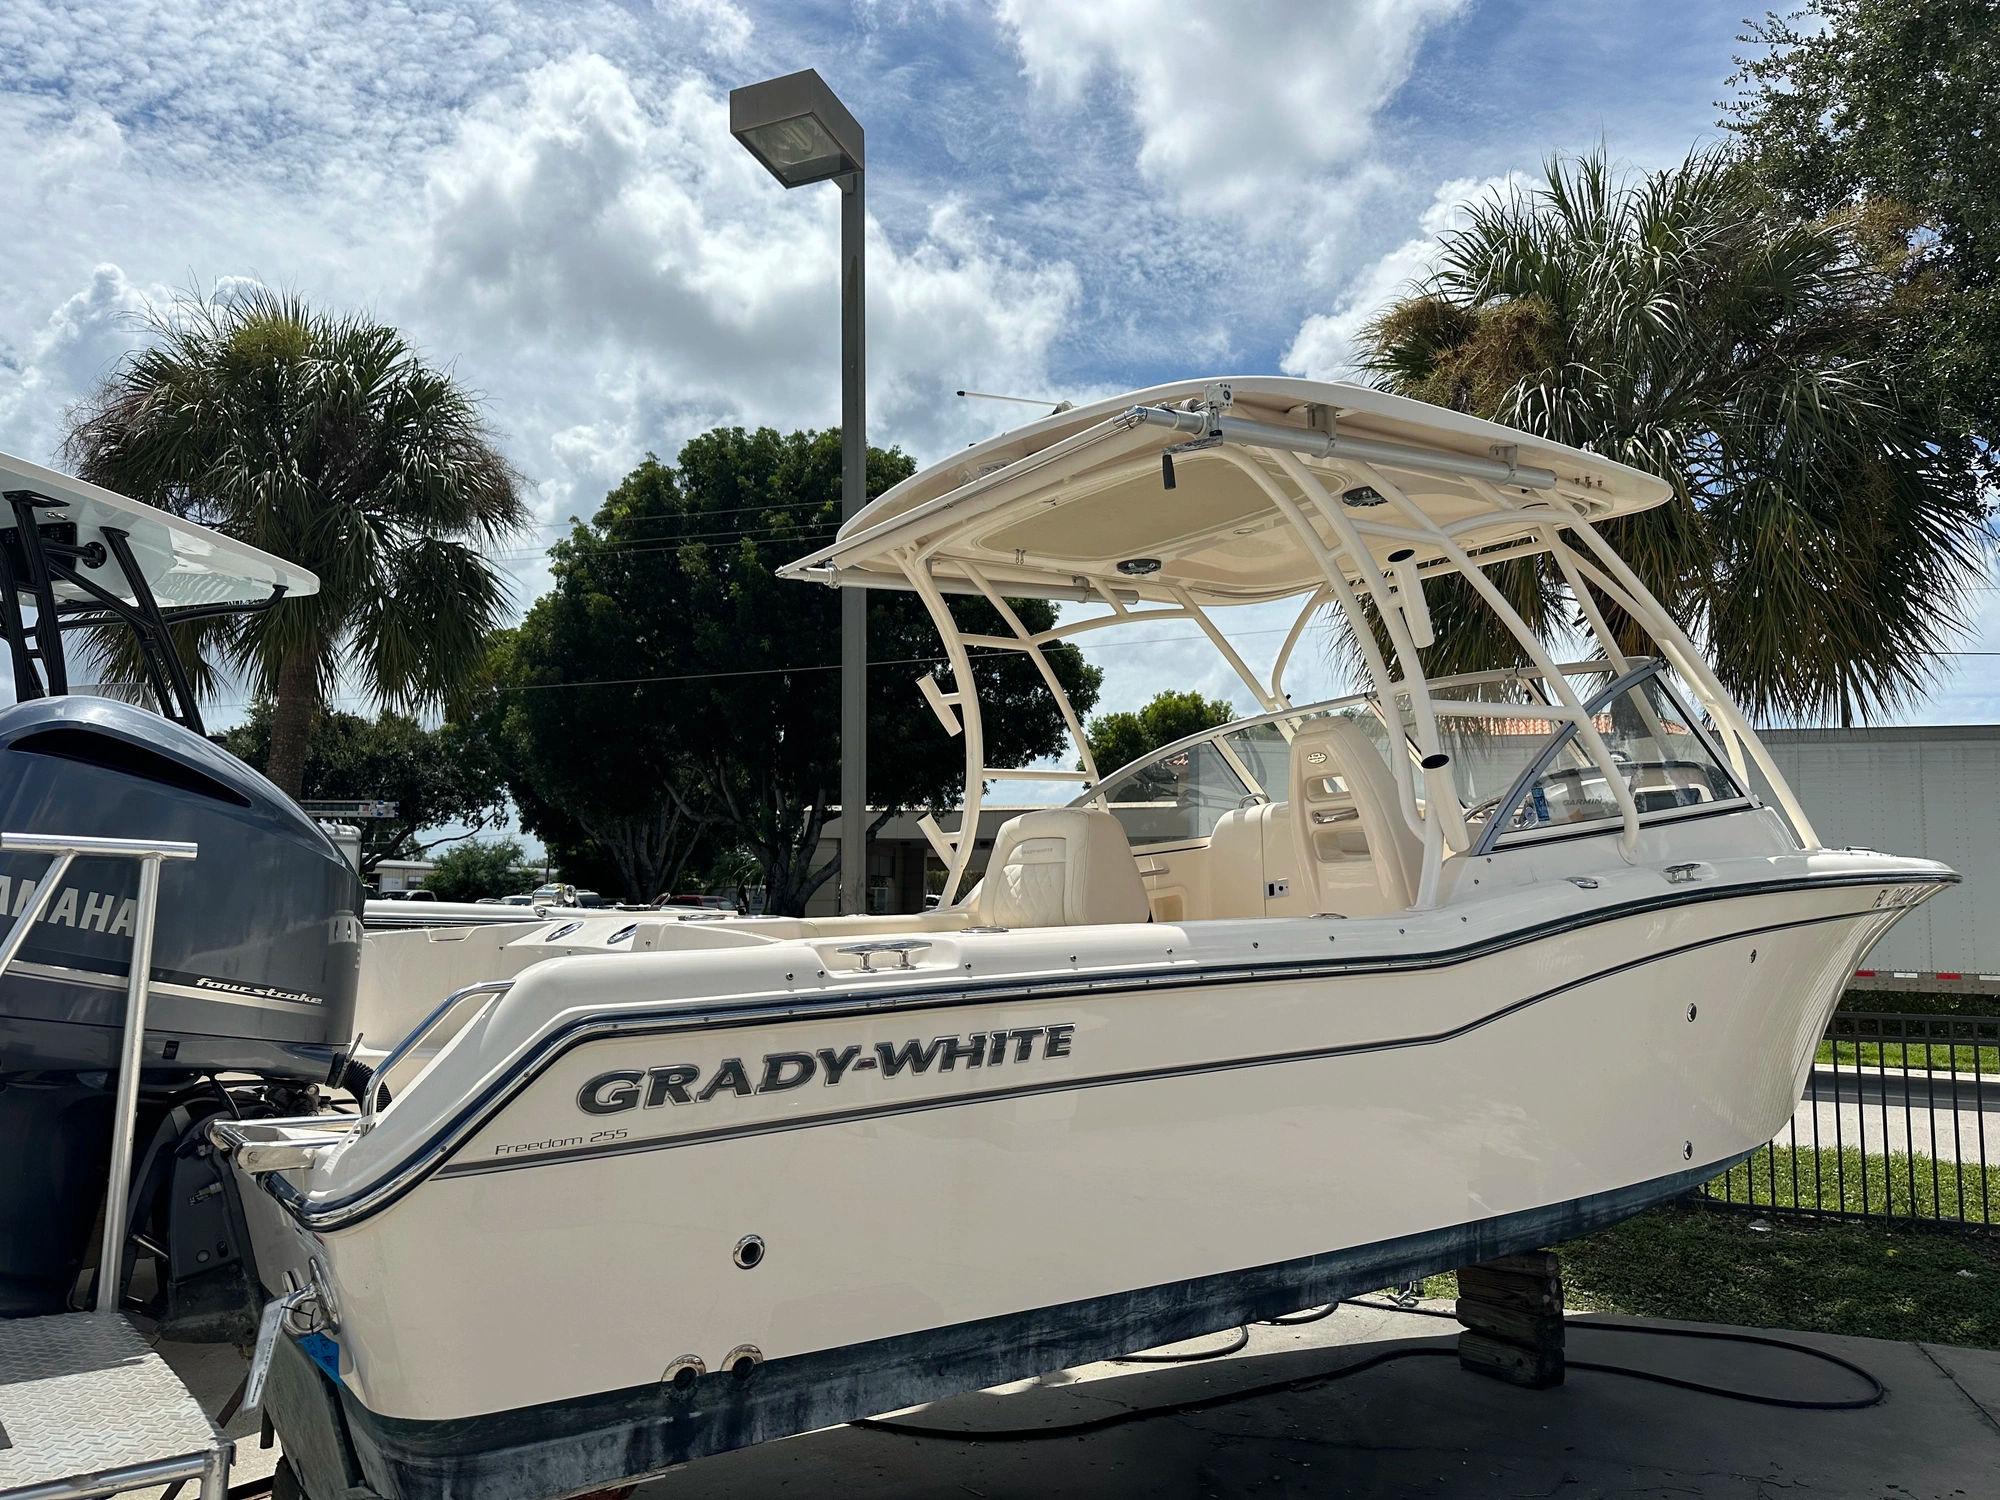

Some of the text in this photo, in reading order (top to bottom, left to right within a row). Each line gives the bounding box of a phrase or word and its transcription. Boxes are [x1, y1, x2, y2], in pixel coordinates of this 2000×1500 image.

[1562, 798, 1603, 807] GARMIN
[576, 1023, 1076, 1116] GRADY-WHITE
[494, 1128, 629, 1155] Freedom 255
